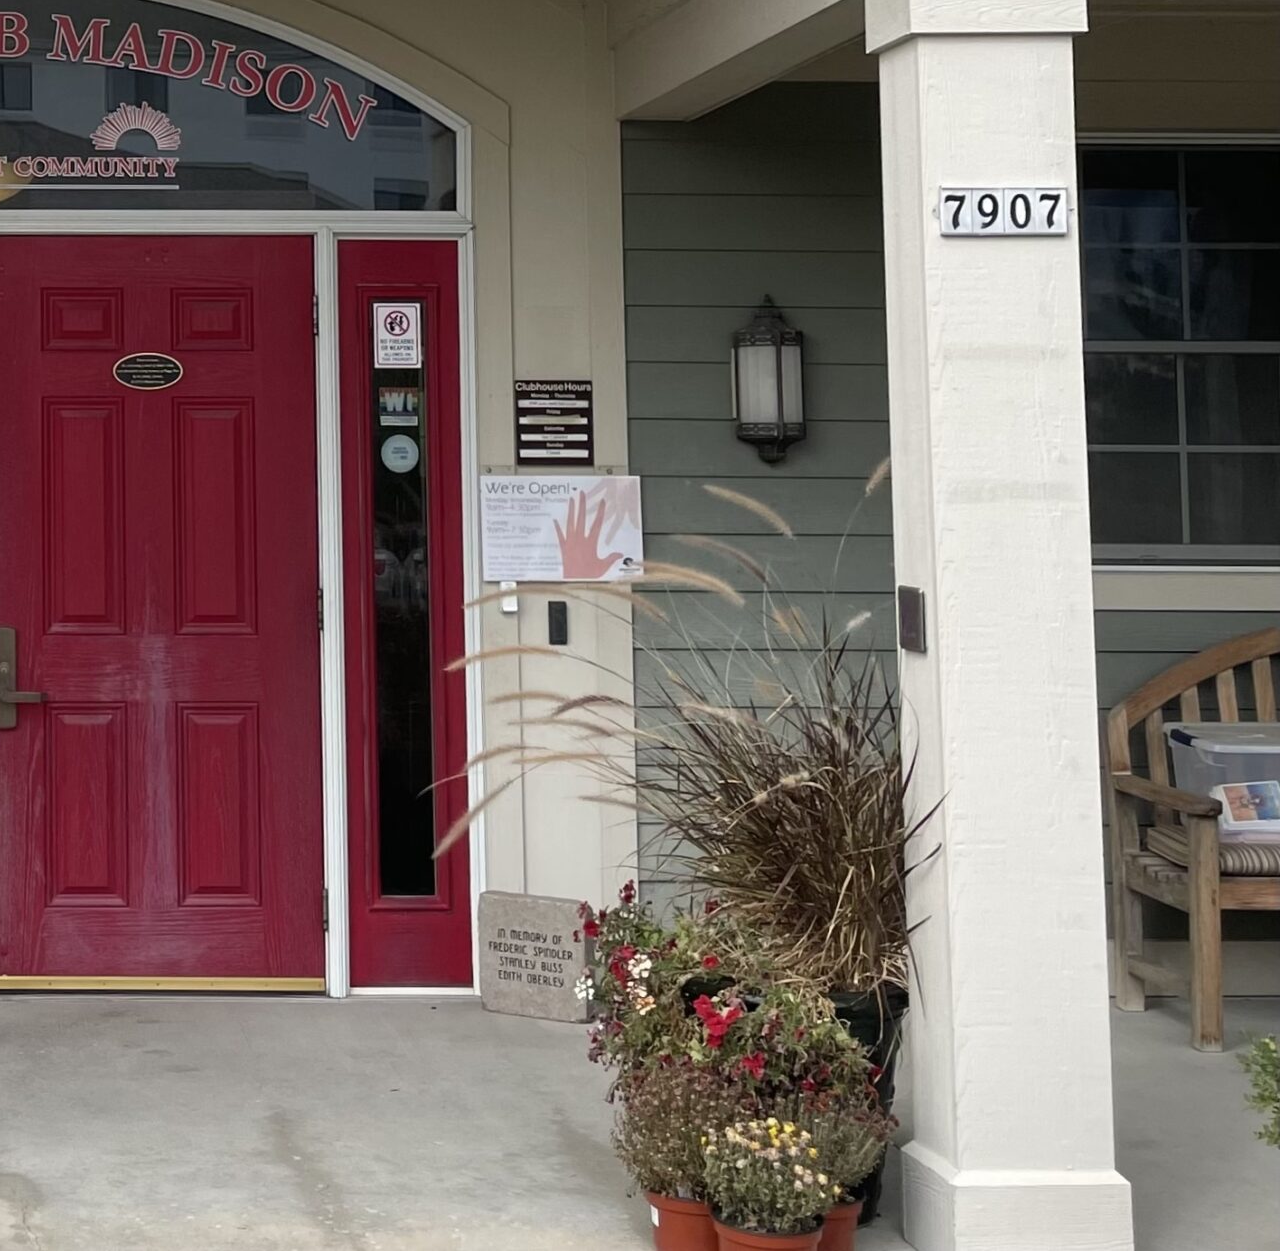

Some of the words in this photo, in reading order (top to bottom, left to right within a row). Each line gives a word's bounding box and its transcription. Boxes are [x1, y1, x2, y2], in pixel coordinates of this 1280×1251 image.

[46, 14, 378, 142] MADISON
[13, 156, 180, 178] COMMUNITY
[944, 193, 1061, 230] 7907
[515, 382, 564, 391] Clubhouse
[564, 382, 591, 391] Hours
[485, 482, 525, 494] We're
[529, 482, 570, 497] Open!
[497, 928, 506, 939] IN
[510, 929, 548, 944] MEMORY
[552, 935, 562, 945] OF
[488, 941, 528, 955] FREDERIC
[533, 946, 574, 961] SPINDLER
[499, 956, 536, 970] STANLEY
[541, 962, 563, 974] BUSS
[498, 969, 522, 982] EDITH
[526, 973, 565, 988] OBERLEY
